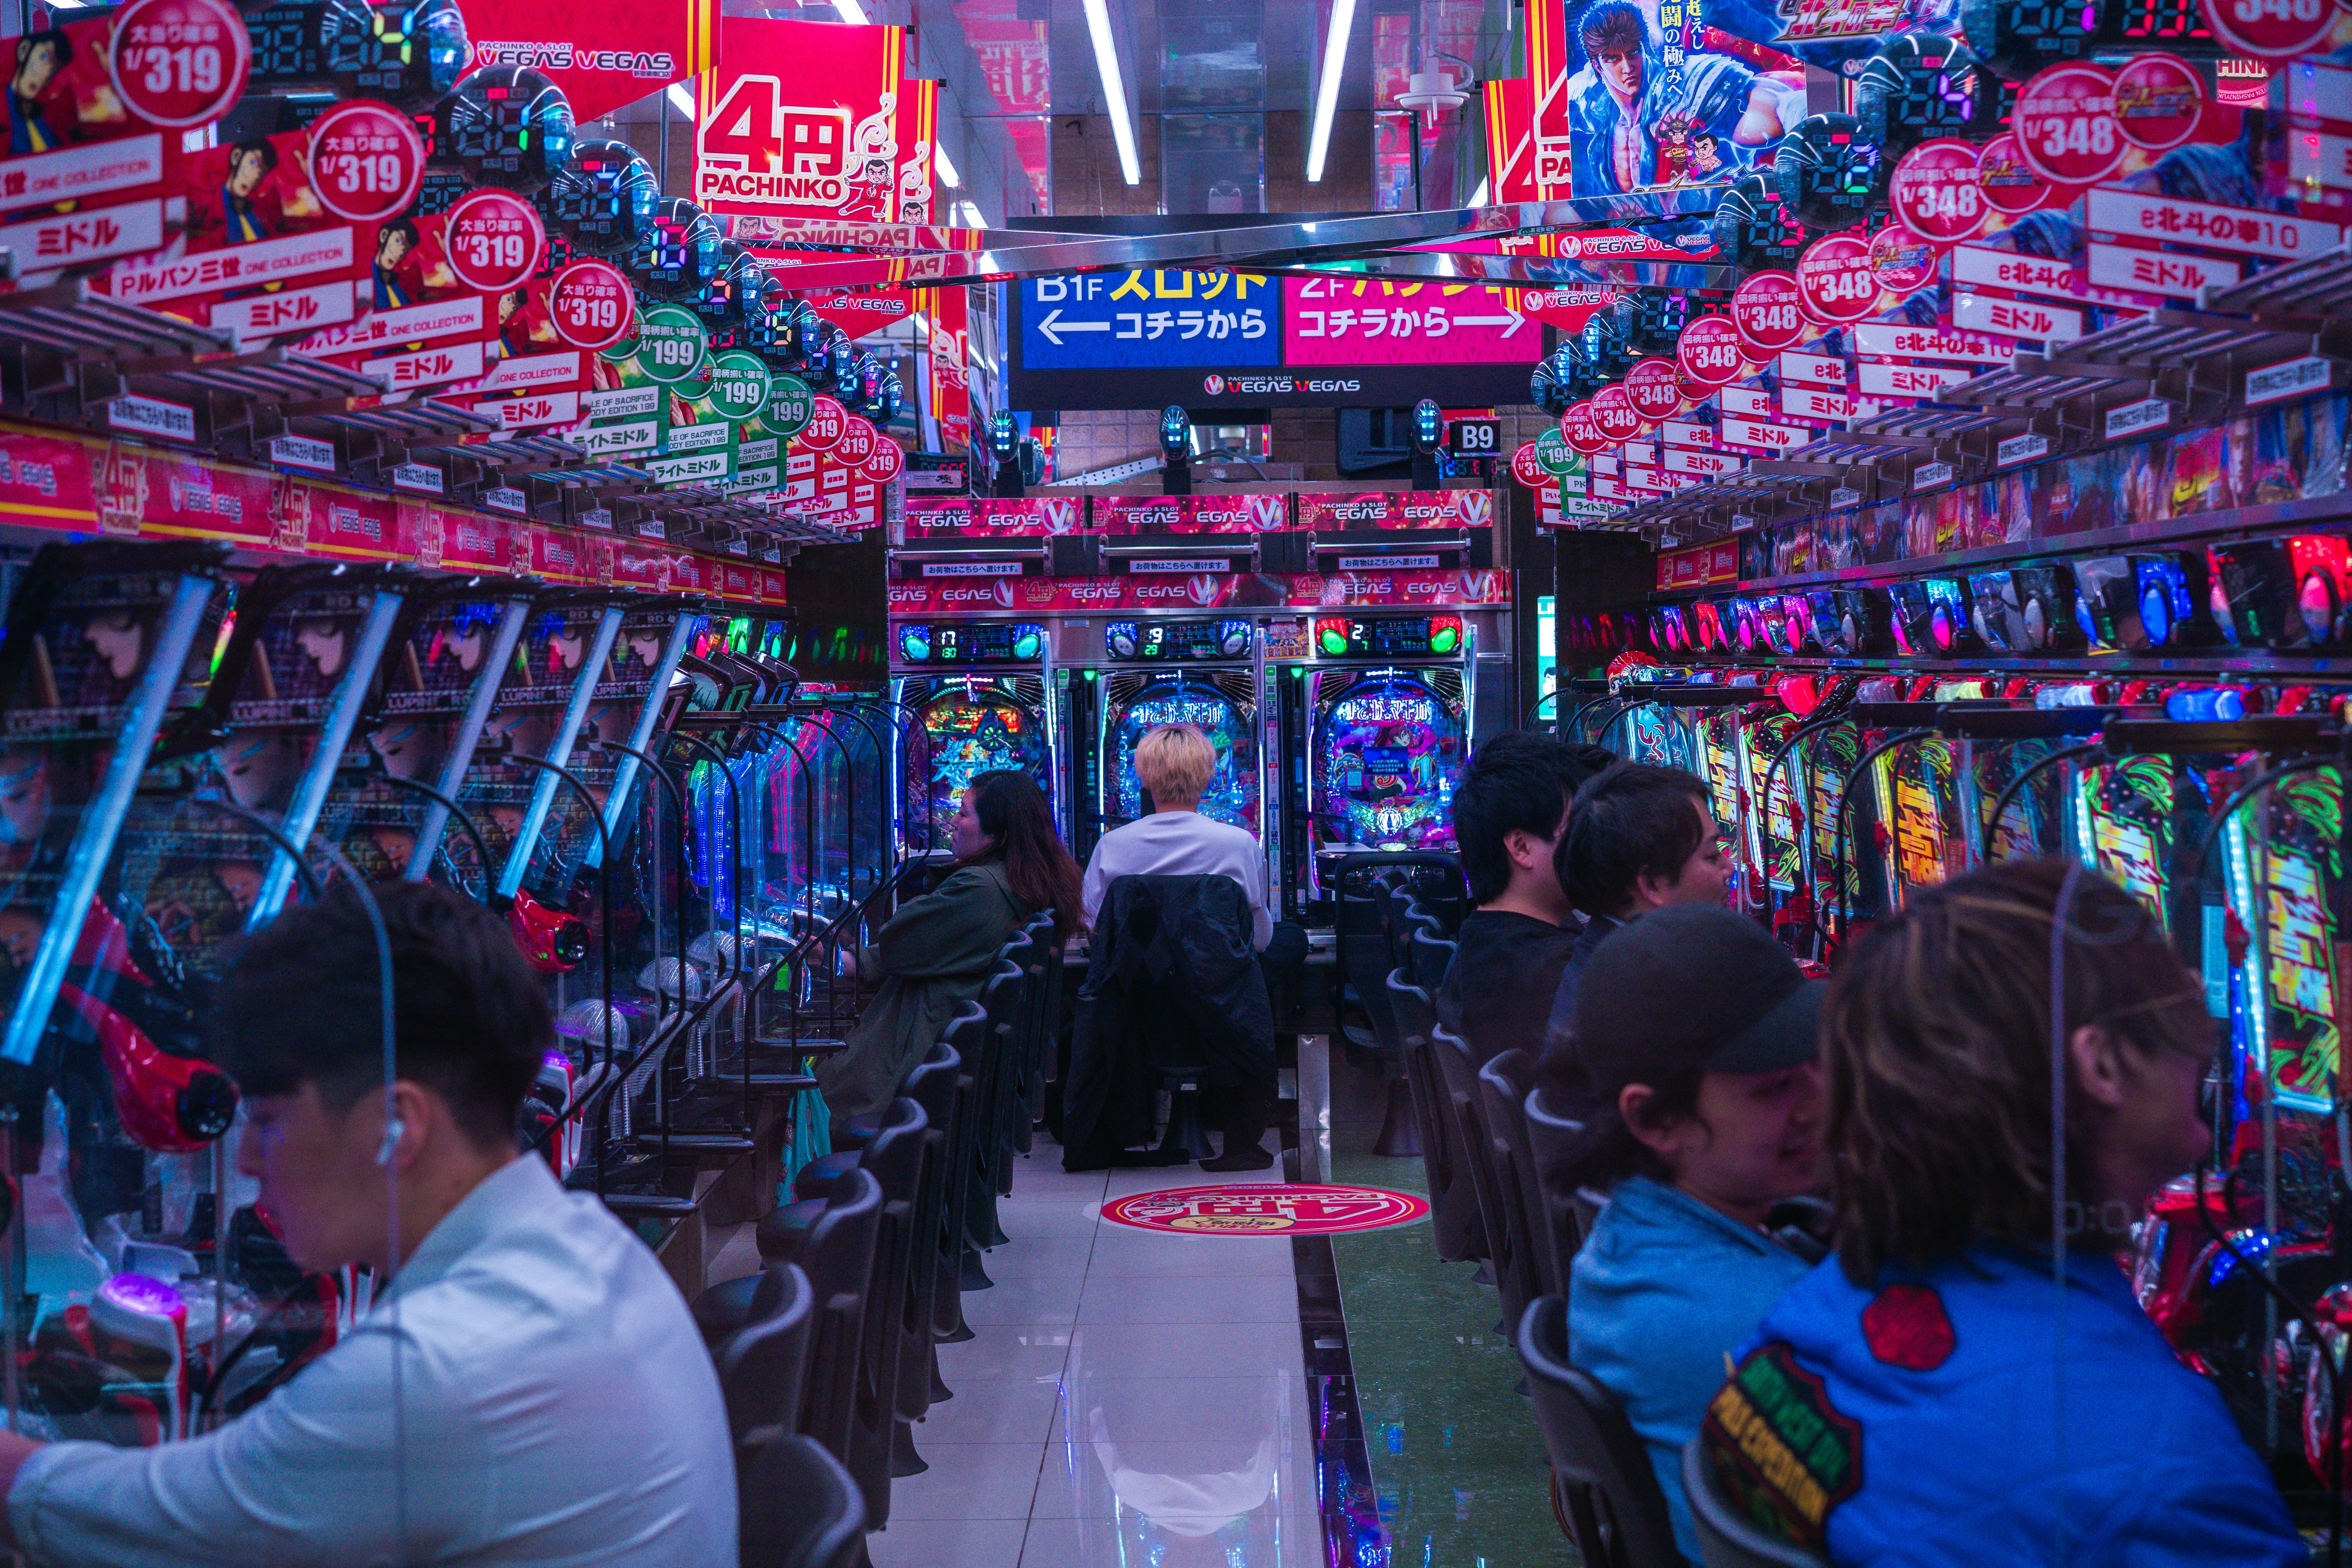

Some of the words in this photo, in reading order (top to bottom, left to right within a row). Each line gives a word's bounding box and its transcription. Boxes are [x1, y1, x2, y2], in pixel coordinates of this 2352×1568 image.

[478, 42, 534, 50] PACHINKO
[479, 50, 572, 67] VEGAS
[578, 53, 671, 69] VEGAS
[123, 45, 221, 93] 1/319
[700, 76, 847, 177] 4円
[2025, 116, 2114, 156] 1/348
[319, 154, 401, 192] 1/319
[702, 175, 841, 200] PACHINKO
[1902, 185, 1977, 218] 1/348
[461, 220, 523, 232] 大当り確率
[36, 215, 119, 255] ミドル
[456, 235, 524, 267] 1/319
[1583, 242, 1645, 253] VEGAS
[120, 259, 242, 297] Pルバン三世
[271, 247, 343, 270] COLLECTION
[2134, 258, 2204, 288] ミドル
[563, 285, 617, 297] 大当り確率
[1037, 276, 1103, 301] B1F
[1110, 270, 1267, 301] スロット
[1807, 270, 1872, 302] 1/348
[849, 299, 903, 310] VEGAS
[1546, 295, 1601, 307] VEGAS
[1737, 292, 1798, 304] 図柄揃い確率
[250, 295, 318, 327] ミドル
[558, 298, 617, 328] 1/319
[1739, 305, 1797, 331] 1/348
[1991, 305, 2053, 333] ミドル
[390, 324, 410, 335] ONE
[414, 315, 474, 332] COLLECTION
[1116, 309, 1266, 339] コチラから
[1299, 307, 1450, 338] コチラから
[1683, 334, 1737, 344] 図柄揃い確率
[642, 340, 694, 365] 1/199
[1685, 345, 1737, 368] 1/348
[395, 355, 452, 380] ミドル
[500, 373, 517, 382] ONE
[520, 367, 572, 379] COLLECTION
[713, 368, 764, 379] 図柄揃い確率
[1228, 382, 1292, 392] VEGAS
[1296, 380, 1360, 392] VEGAS
[1628, 374, 1676, 385] 図柄揃い確率
[1893, 371, 1946, 390] ミドル
[615, 394, 654, 405] SACRIFICE
[713, 382, 760, 404] 1/199
[1630, 385, 1675, 405] 1/348
[503, 401, 551, 421] ミドル
[609, 405, 638, 414] EDITION
[641, 403, 655, 411] 199
[1811, 396, 1857, 416] ミドル
[1595, 409, 1636, 427] 1/348
[691, 429, 725, 439] SACRIFICE
[808, 420, 837, 437] 319
[1463, 425, 1494, 448] B9
[1748, 427, 1790, 445] ミドル
[685, 439, 711, 448] EDITION
[744, 445, 774, 454] SACRIFICE
[841, 438, 867, 454] 319
[869, 456, 894, 470] 319
[1540, 447, 1573, 463] 1/199
[1687, 456, 1723, 471] ミドル
[1647, 474, 1680, 487] ミドル
[906, 515, 971, 527] VEGAS
[975, 514, 1041, 526] VEGAS
[1114, 512, 1180, 523] VEGAS
[1184, 511, 1250, 523] VEGAS
[1322, 508, 1387, 520] VEGAS
[1391, 507, 1457, 519] VEGAS
[929, 565, 1018, 574] お荷物はこちらへ置けます。
[1136, 561, 1225, 570] お荷物はこちらへ置けます。
[1345, 558, 1434, 567] お荷物はこちらへ置けます。
[1027, 581, 1054, 596] 4円
[1060, 588, 1121, 599] VEGAS
[1124, 586, 1185, 597] VEGAS
[1297, 578, 1322, 593] 4円
[1396, 583, 1457, 593] VEGAS
[889, 591, 927, 601] GAS
[931, 589, 992, 601] VEGAS
[1352, 624, 1363, 640] 2
[1145, 645, 1158, 655] 29
[1362, 641, 1368, 650] 7
[1194, 1200, 1389, 1221] 4円
